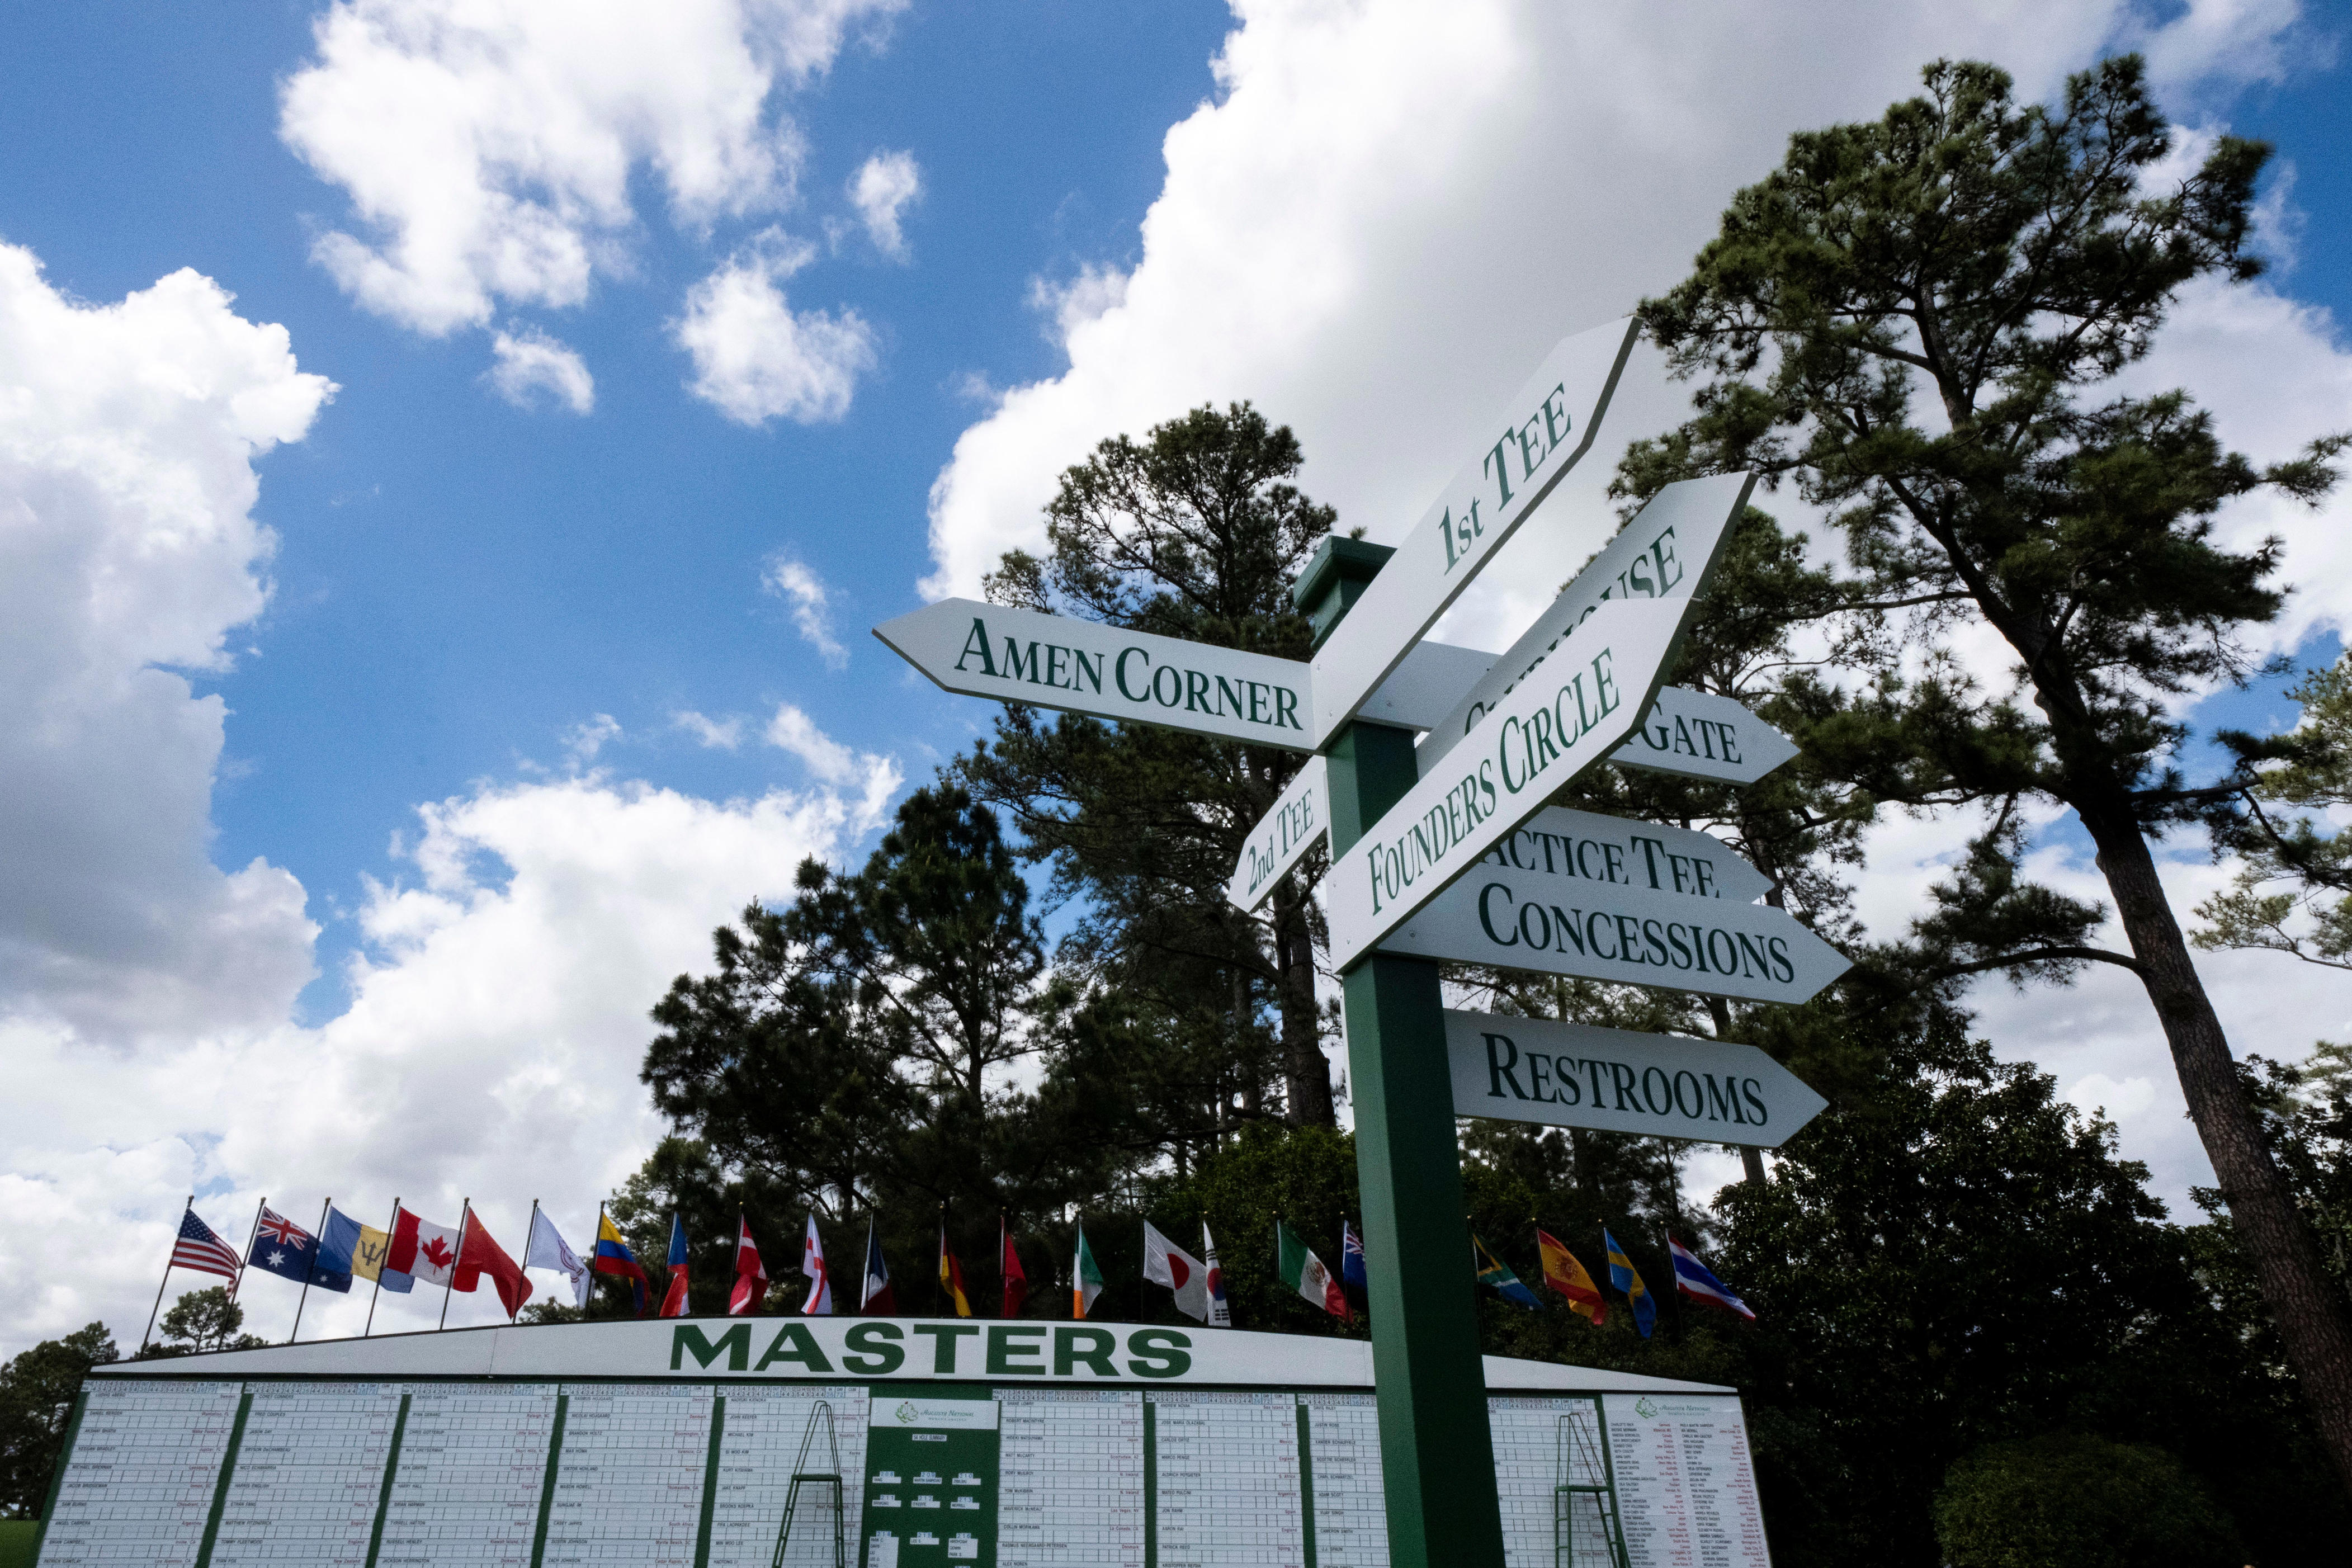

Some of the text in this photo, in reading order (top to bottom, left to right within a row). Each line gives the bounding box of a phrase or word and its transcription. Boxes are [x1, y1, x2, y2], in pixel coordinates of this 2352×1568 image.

[1438, 381, 1572, 577] 1st TEE
[954, 617, 1303, 731] AMEN CORNER
[1367, 646, 1621, 917] FOUNDERS CIRCLE
[1247, 787, 1314, 897] 2nd TEE
[1480, 828, 1721, 899] CTICE TEE
[1478, 882, 1795, 984] CONCESSIONS
[1480, 1032, 1768, 1127] RESTROOMS
[669, 1321, 1192, 1378] MASTERS
